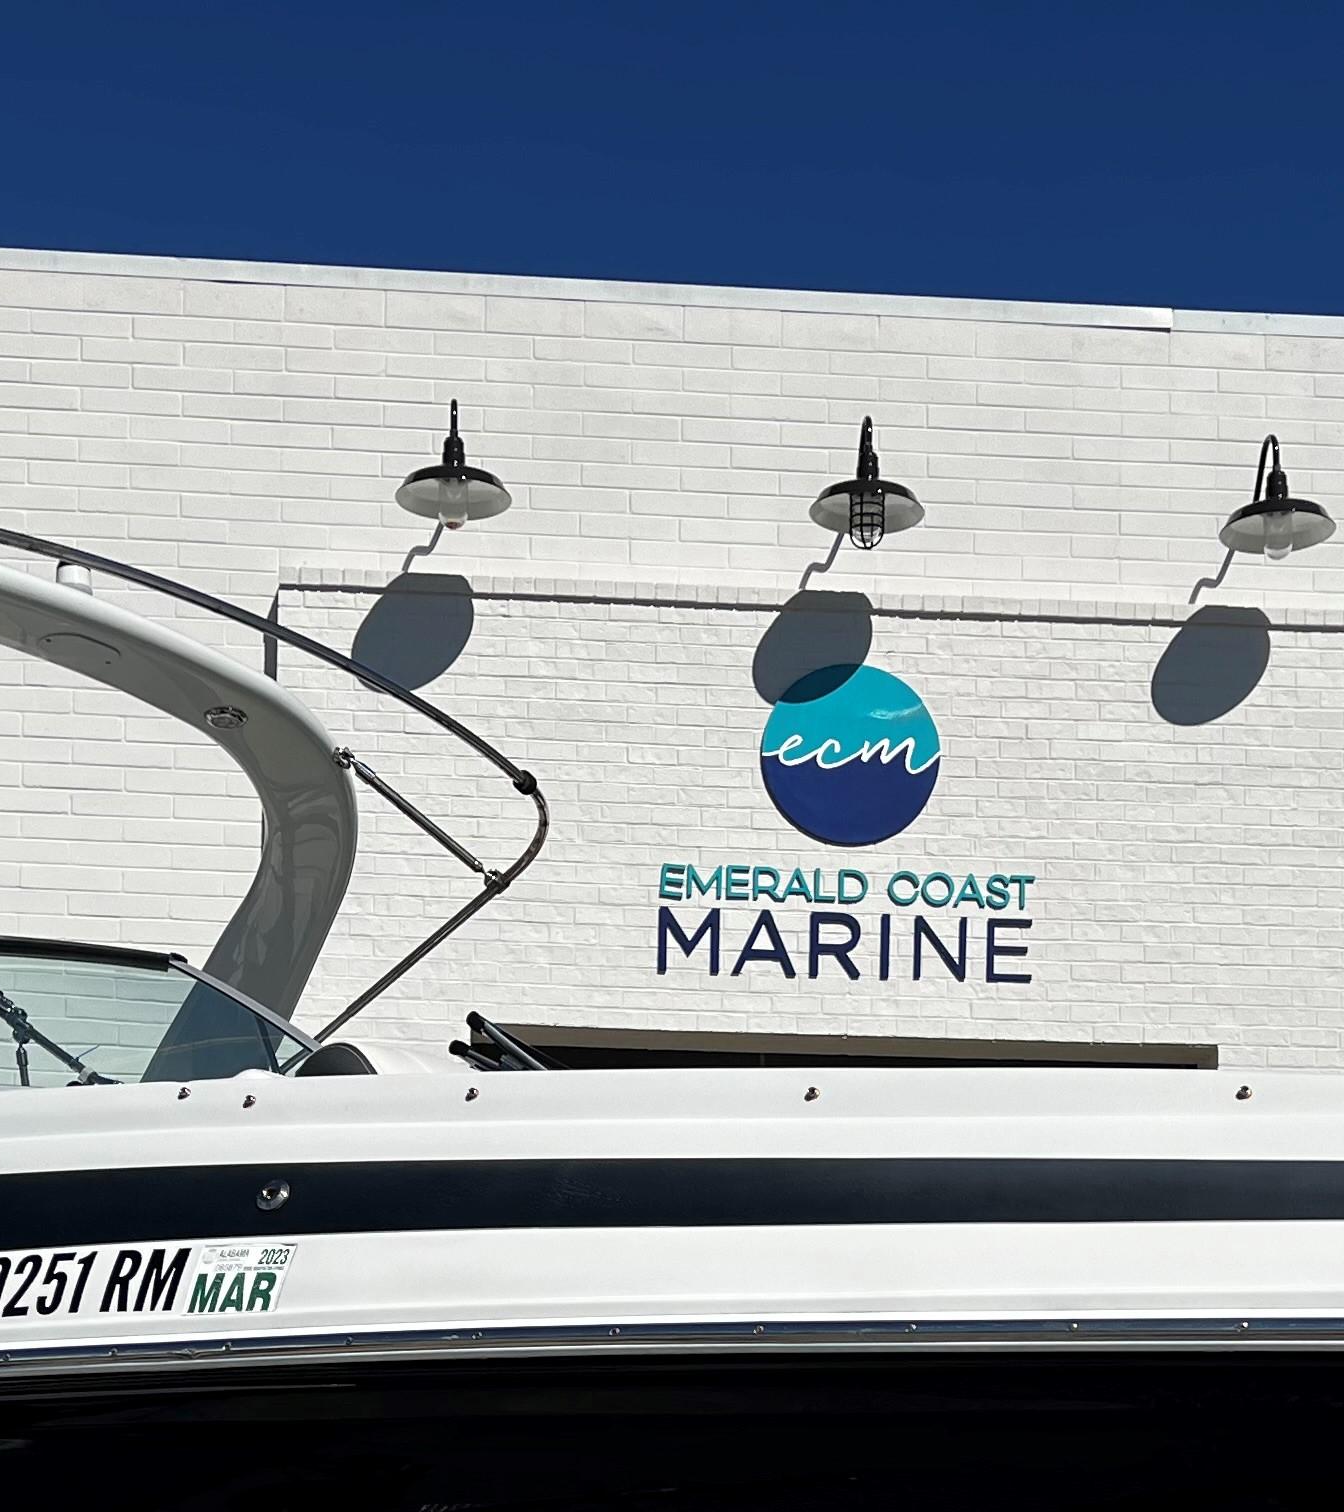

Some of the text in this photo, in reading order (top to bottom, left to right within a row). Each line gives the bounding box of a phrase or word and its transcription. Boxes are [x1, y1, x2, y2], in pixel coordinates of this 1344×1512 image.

[761, 733, 942, 775] ecm
[658, 863, 1036, 911] EMERALD COAST
[656, 906, 1033, 985] MARINE
[257, 1248, 290, 1265] 2023
[99, 1247, 192, 1312] RM
[187, 1272, 277, 1313] MAR
